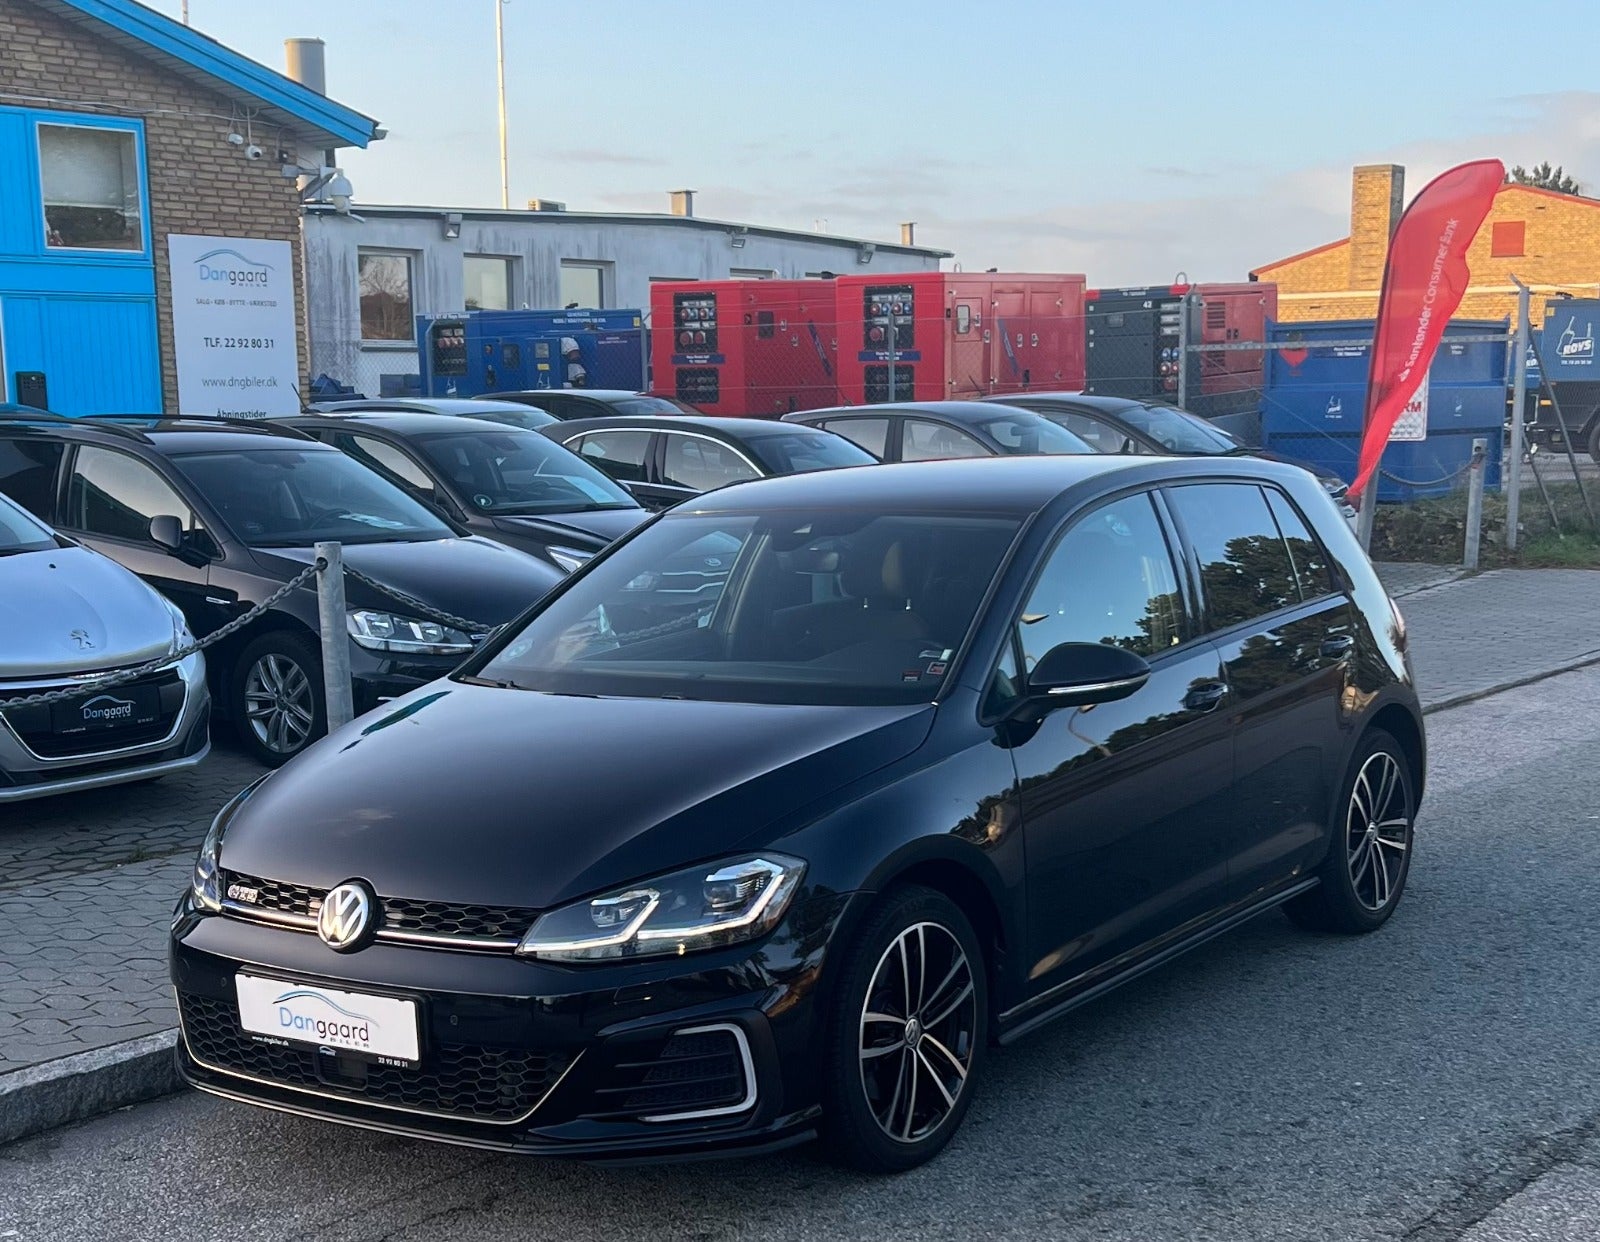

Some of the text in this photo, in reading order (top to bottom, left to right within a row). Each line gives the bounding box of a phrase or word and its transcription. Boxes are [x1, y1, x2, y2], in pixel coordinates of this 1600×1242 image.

[199, 264, 268, 286] Dangaard
[1405, 218, 1460, 368] Santander Consumer Bank
[203, 337, 275, 349] TLF. 22 92 80 31
[201, 376, 279, 390] www.dngbiler.dk
[83, 702, 132, 720] Dangaard
[279, 1006, 370, 1042] Dangaard
